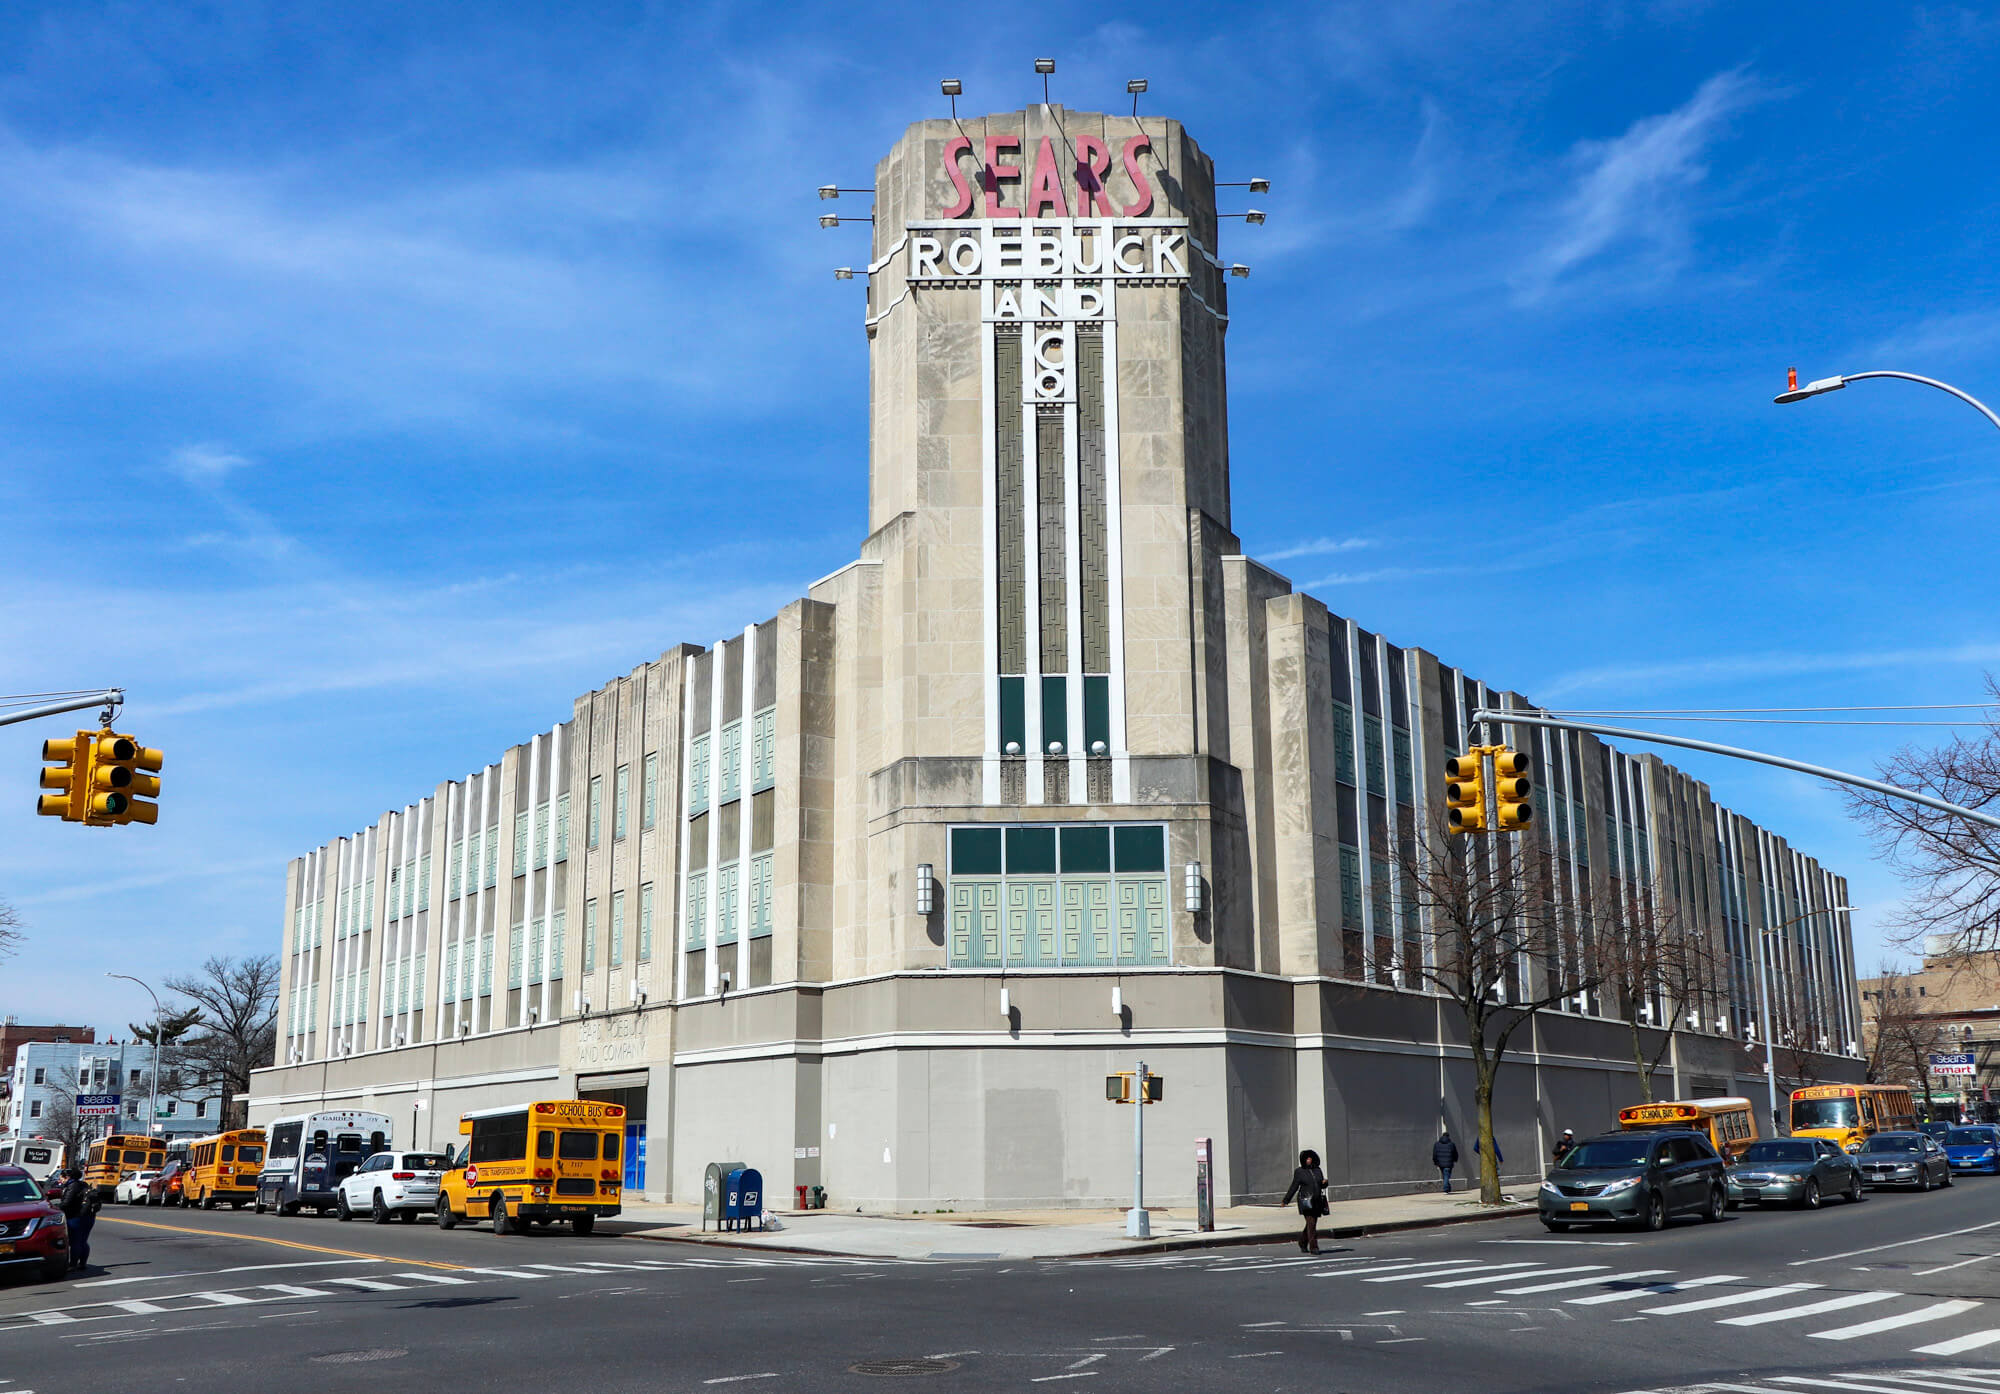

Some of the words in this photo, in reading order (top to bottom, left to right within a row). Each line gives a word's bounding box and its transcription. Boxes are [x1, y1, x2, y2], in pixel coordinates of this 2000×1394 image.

[943, 135, 1153, 218] SEARS
[911, 233, 1186, 276] ROEBUCK
[993, 288, 1105, 318] AND
[1936, 1054, 1967, 1063] sears
[1934, 1066, 1972, 1074] kmart
[83, 1095, 113, 1104] sears
[79, 1106, 116, 1114] kmart
[560, 1104, 586, 1117] SCHOOL
[588, 1106, 602, 1117] BUS
[1641, 1109, 1662, 1119] SCHOOL
[1663, 1109, 1674, 1118] BUS
